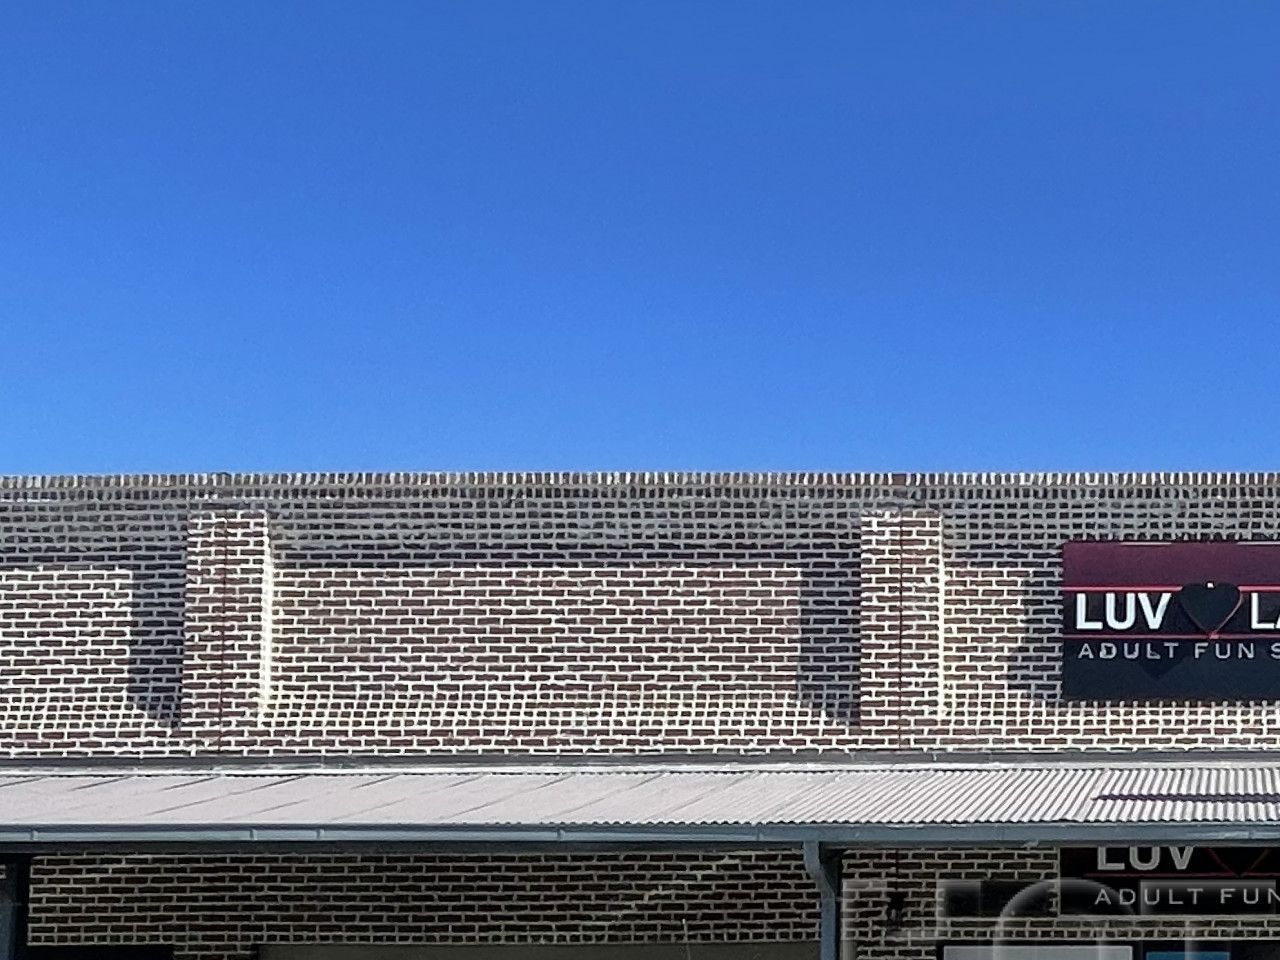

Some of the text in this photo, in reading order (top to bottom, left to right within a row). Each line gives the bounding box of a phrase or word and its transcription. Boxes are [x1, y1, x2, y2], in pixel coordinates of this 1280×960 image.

[1075, 592, 1171, 630] LUV
[1077, 642, 1179, 660] ADULT
[1194, 642, 1255, 659] FUN
[1094, 887, 1203, 905] ADULT
